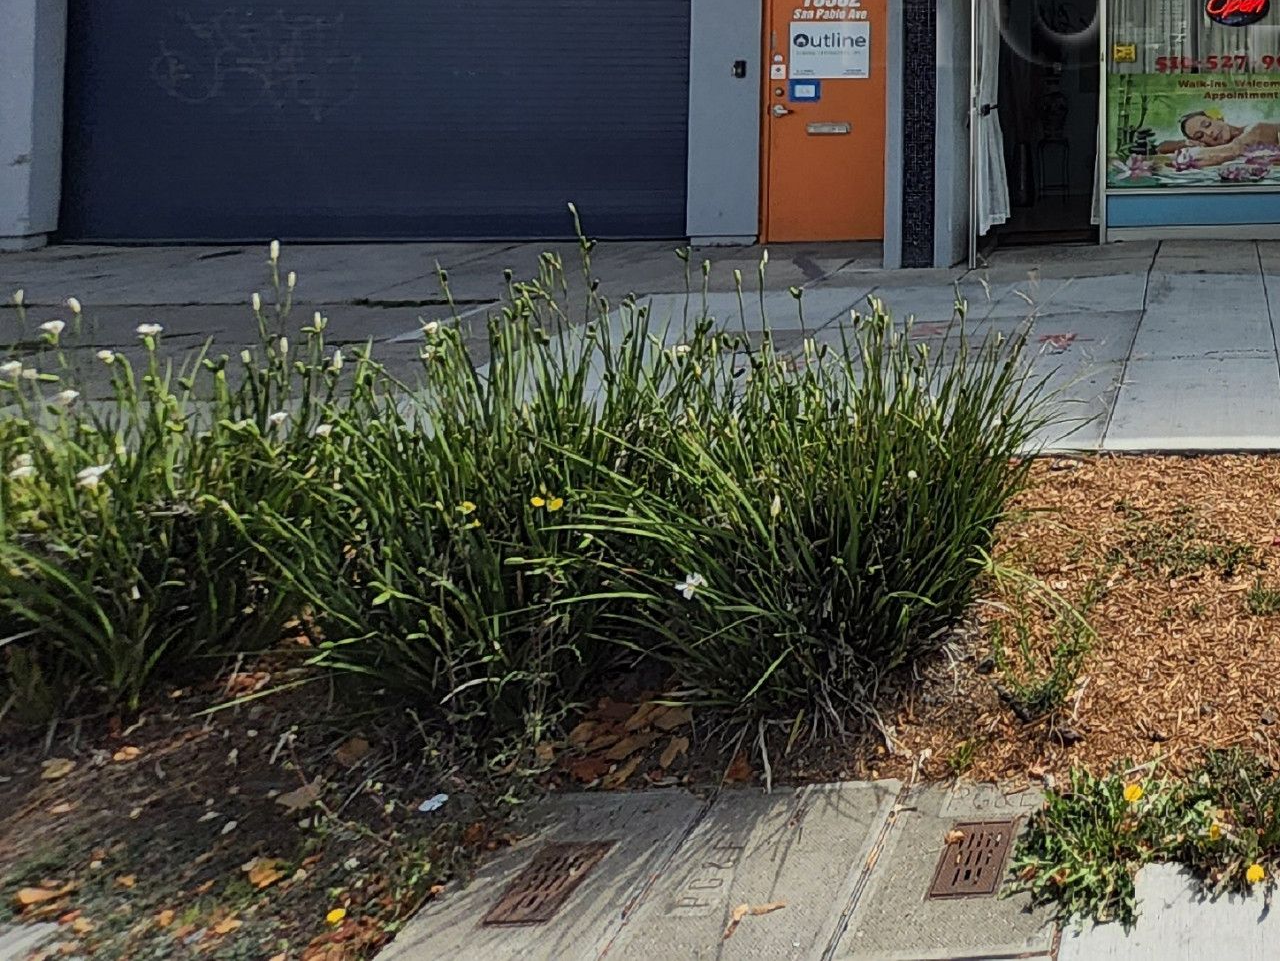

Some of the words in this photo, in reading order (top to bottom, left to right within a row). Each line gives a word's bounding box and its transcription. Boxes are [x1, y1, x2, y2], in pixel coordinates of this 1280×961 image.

[793, 8, 814, 20] San
[816, 8, 846, 20] Pablo
[847, 8, 868, 20] Ave
[793, 32, 867, 48] Outline
[1203, 91, 1279, 101] Appointment
